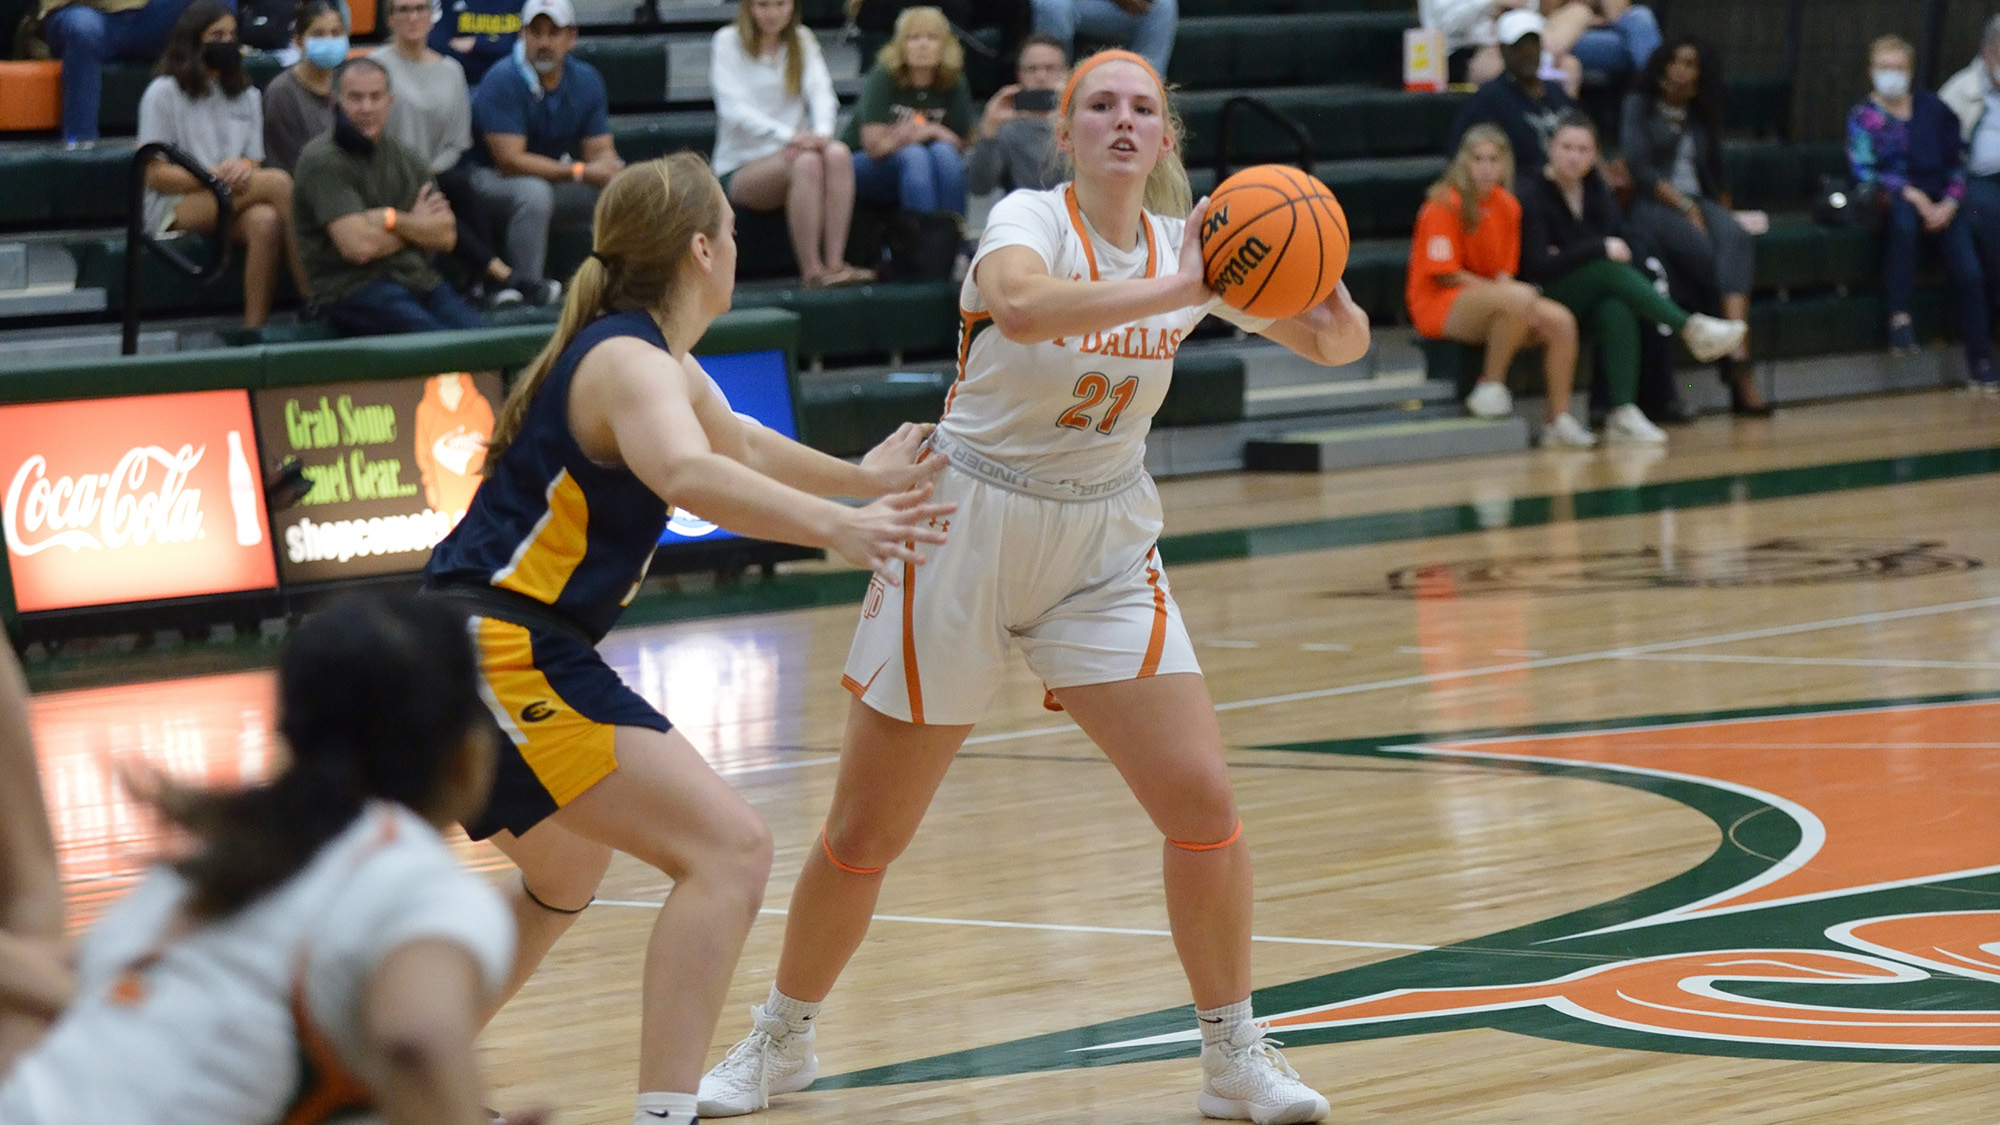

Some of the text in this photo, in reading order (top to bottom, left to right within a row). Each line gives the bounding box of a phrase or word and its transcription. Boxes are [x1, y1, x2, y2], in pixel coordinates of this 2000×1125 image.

[1213, 236, 1272, 297] Wilso
[1079, 326, 1184, 361] DALLAS
[285, 394, 397, 450] Grab Some
[1056, 371, 1140, 436] 21
[951, 445, 1029, 489] UNDER
[4, 443, 206, 557] Coca-Cola
